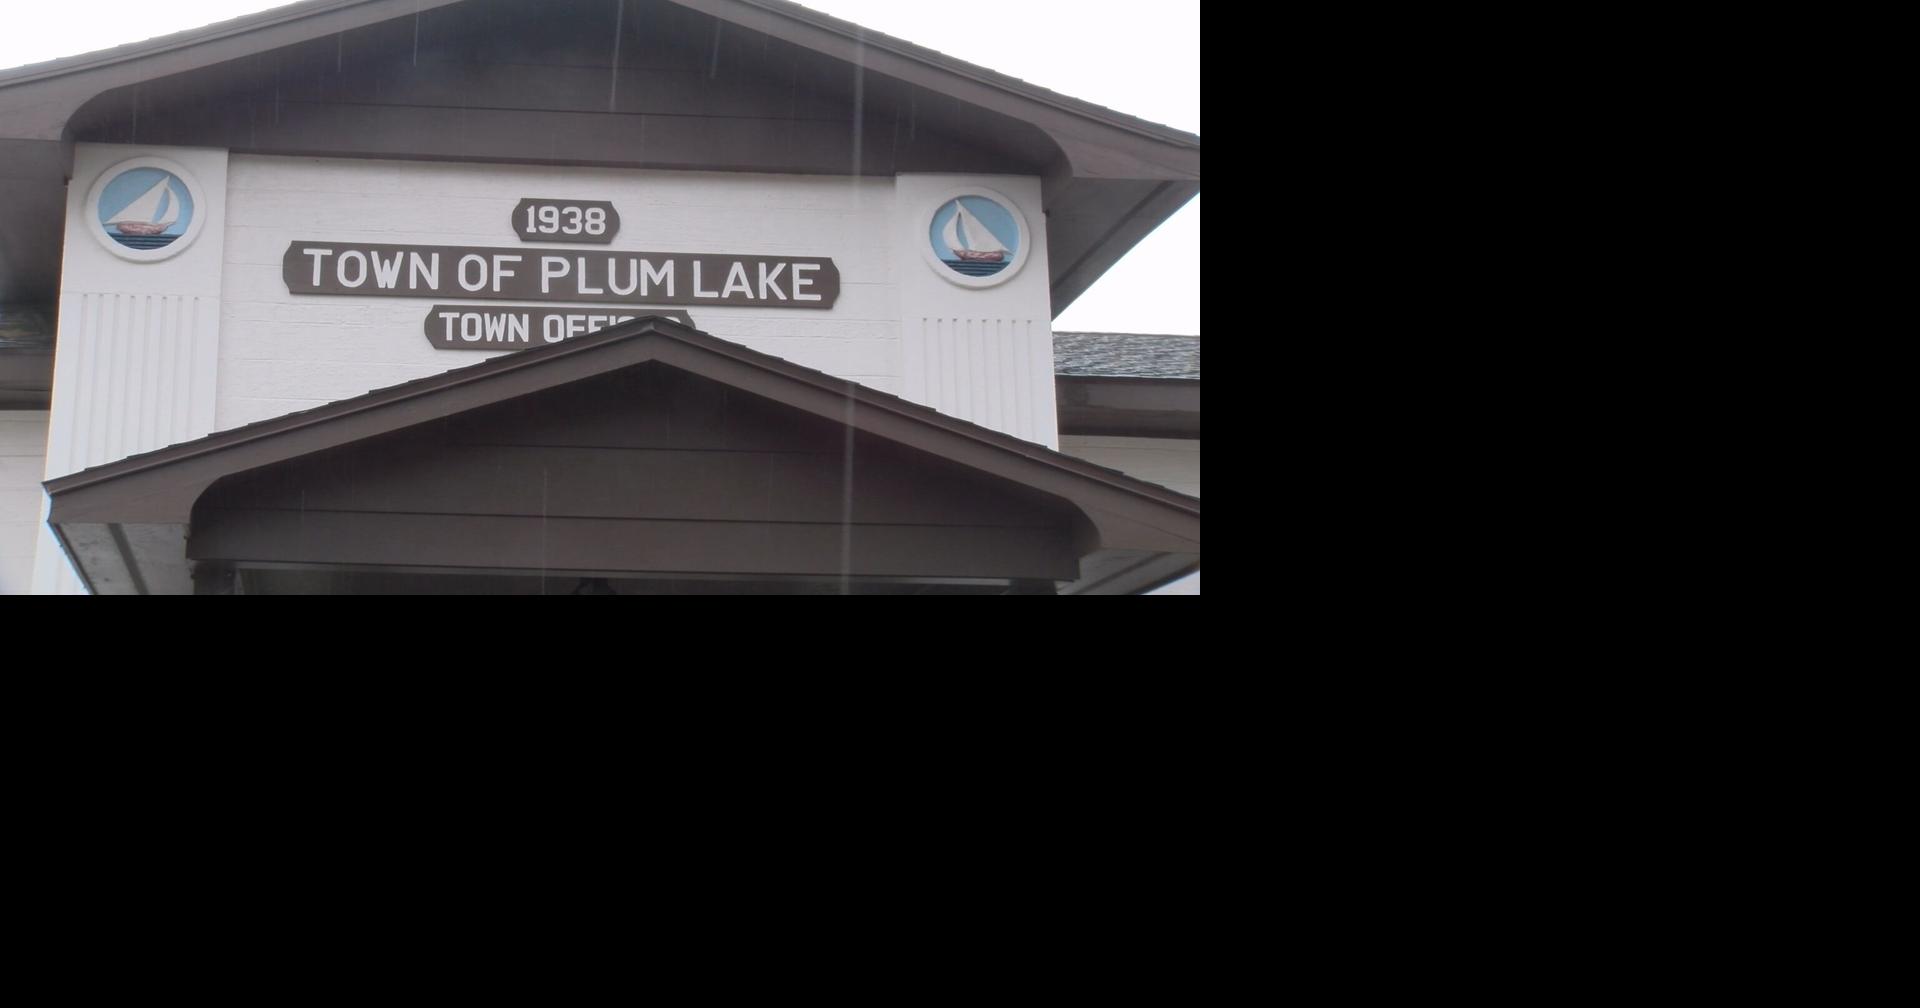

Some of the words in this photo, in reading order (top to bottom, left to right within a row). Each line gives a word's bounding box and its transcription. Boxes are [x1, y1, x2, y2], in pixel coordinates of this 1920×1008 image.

[525, 205, 606, 236] 1938
[302, 248, 440, 290] TOWN
[457, 253, 523, 293] OF
[541, 255, 675, 297] PLUM
[692, 260, 822, 301] LAKE
[438, 311, 530, 343] TOWN
